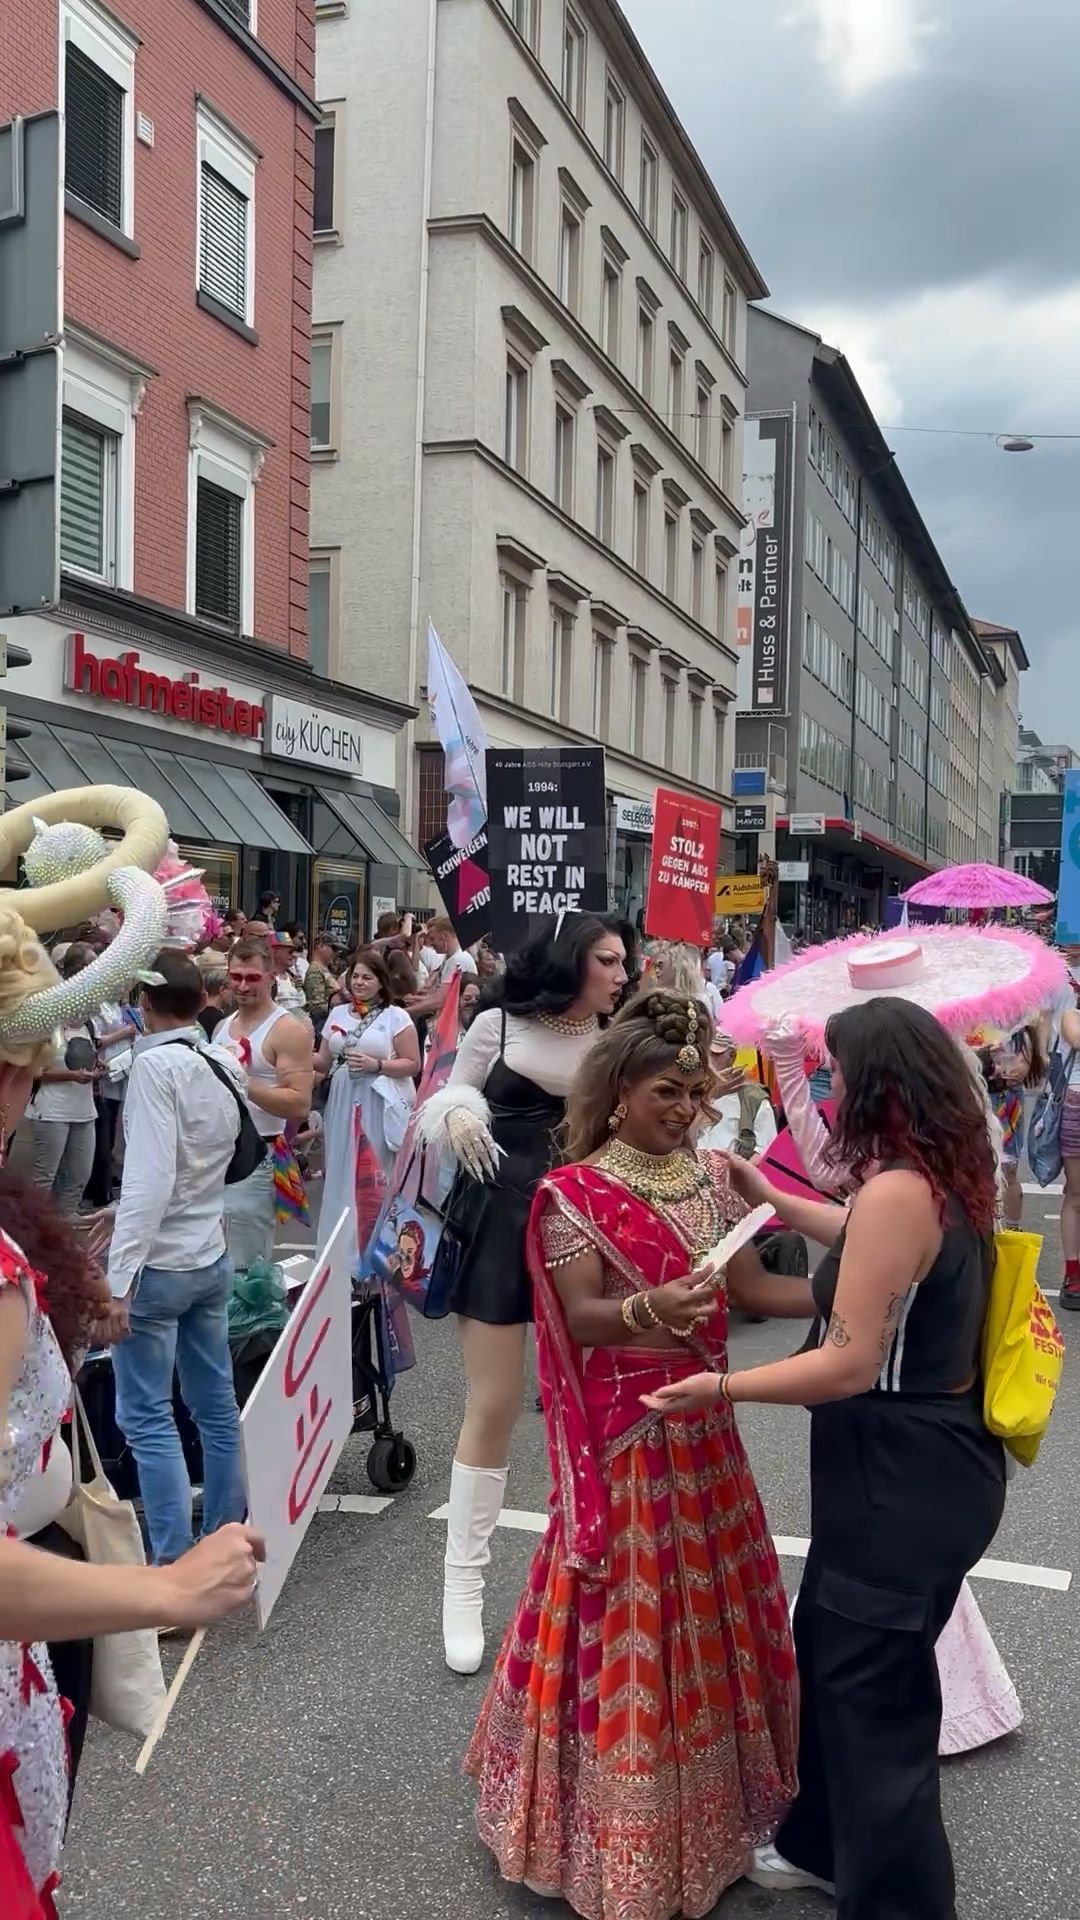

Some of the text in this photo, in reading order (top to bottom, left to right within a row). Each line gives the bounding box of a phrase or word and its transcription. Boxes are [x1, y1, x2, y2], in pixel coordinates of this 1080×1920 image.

[757, 535, 778, 682] Huss & Partner
[69, 633, 266, 740] hofmeister
[275, 707, 361, 765] city KÜCHEN
[528, 782, 558, 793] 1994:
[503, 806, 585, 829] WE WILL
[736, 818, 764, 826] MAVEO
[437, 832, 489, 880] SCHWEIGEN
[521, 833, 568, 861] NOT
[670, 836, 705, 859] STOLZ
[507, 864, 585, 889] REST IN
[661, 855, 709, 878] GEGEN AIDS
[658, 870, 710, 895] ZU KÄMPFEN
[513, 891, 581, 914] PEACE
